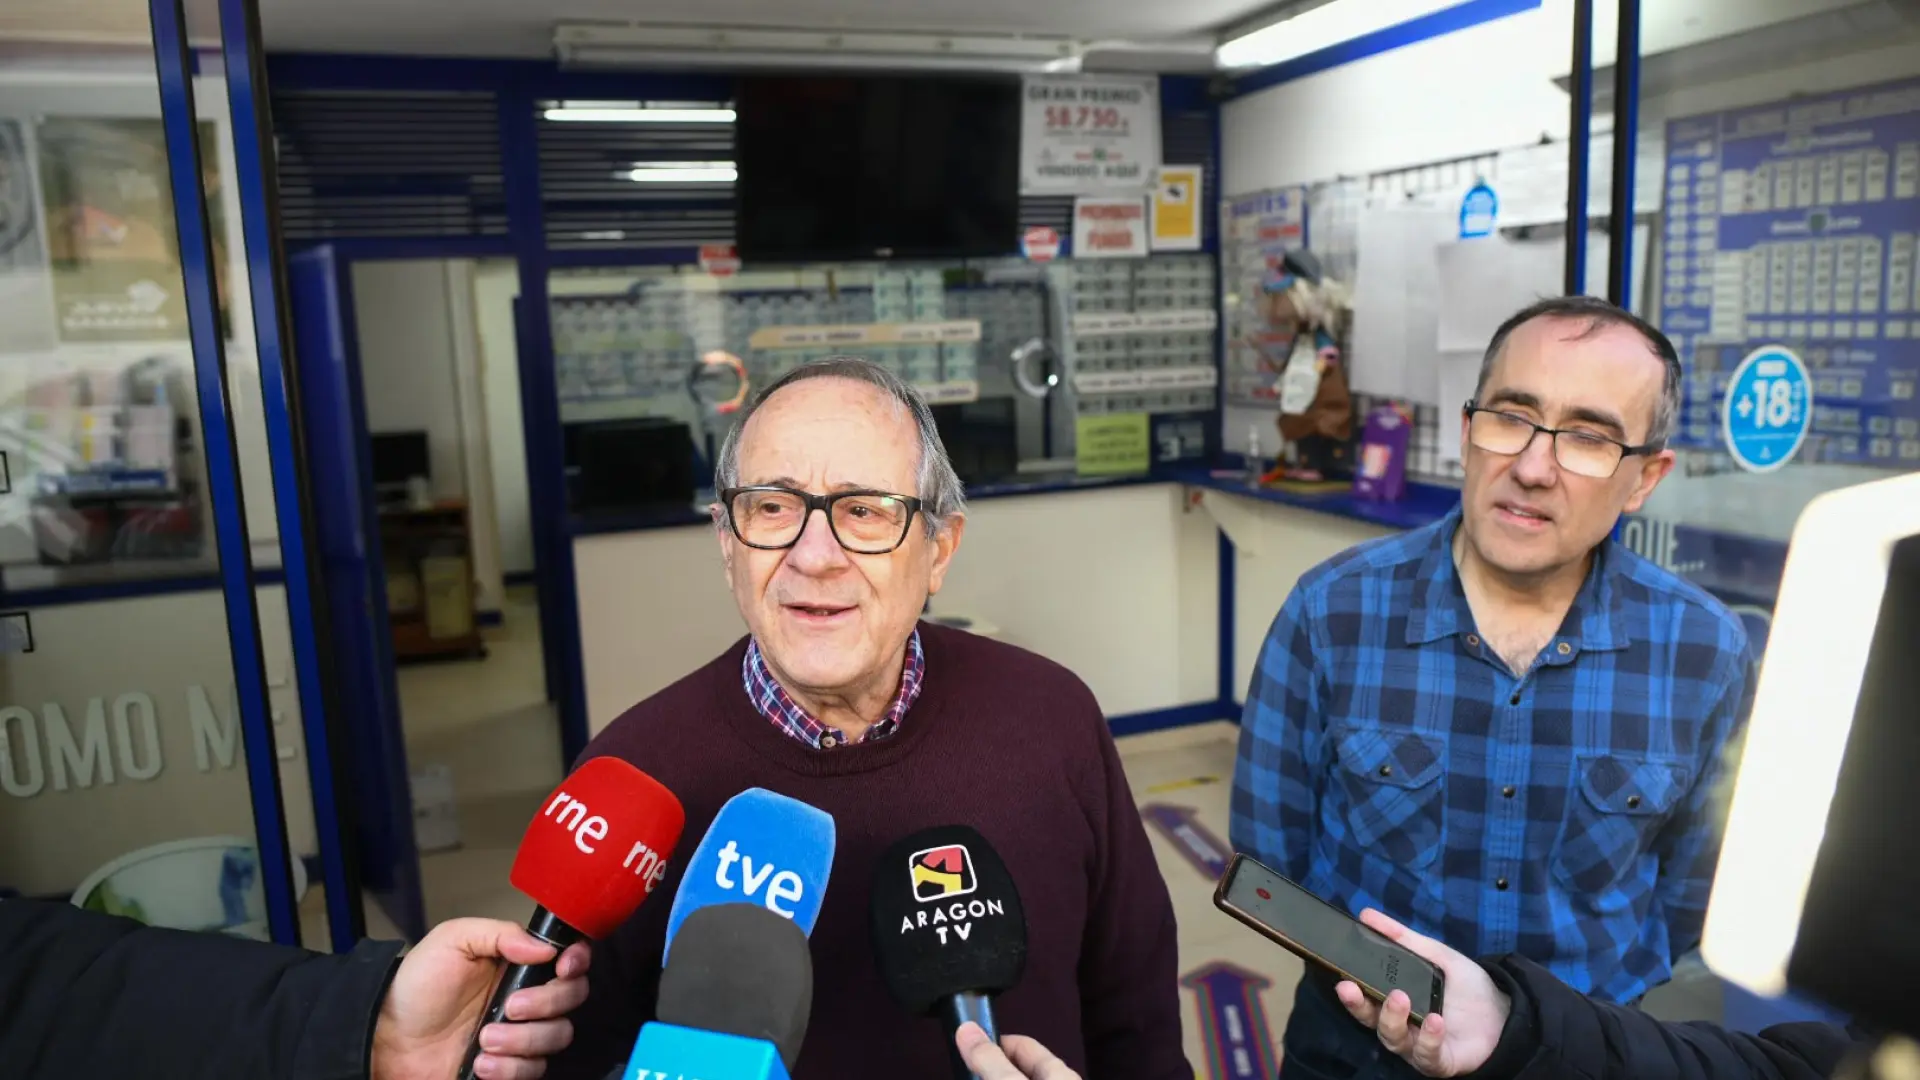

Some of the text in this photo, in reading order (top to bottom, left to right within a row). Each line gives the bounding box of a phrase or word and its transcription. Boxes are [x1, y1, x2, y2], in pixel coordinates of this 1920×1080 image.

[1029, 85, 1142, 103] GRAN PREMIO
[1735, 378, 1793, 429] +18
[545, 791, 609, 854] rne
[622, 840, 666, 893] rne
[715, 840, 803, 919] tve
[901, 899, 1004, 934] ARAGON
[936, 922, 972, 944] TV
